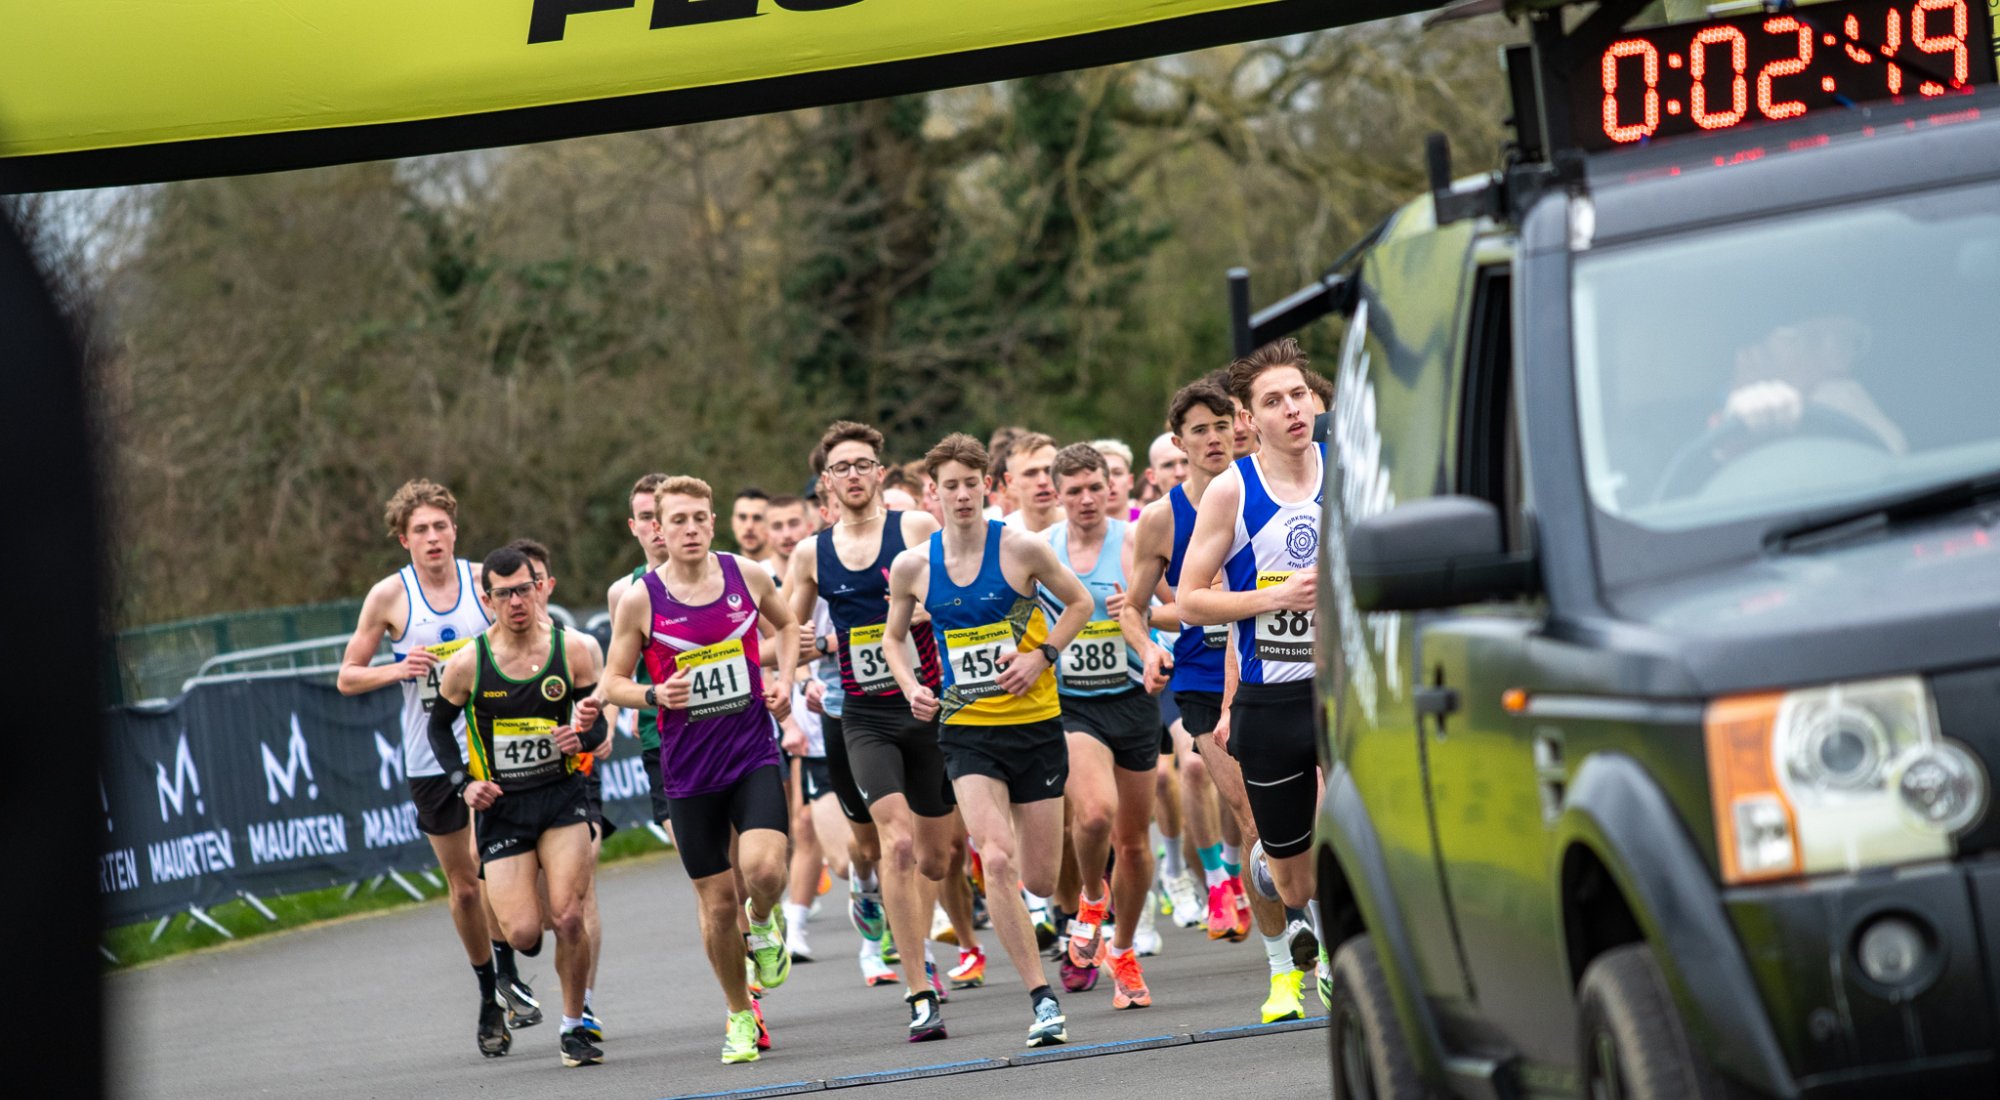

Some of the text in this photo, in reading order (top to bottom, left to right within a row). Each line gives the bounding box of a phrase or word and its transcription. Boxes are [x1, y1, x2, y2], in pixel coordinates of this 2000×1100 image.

[1602, 0, 1968, 142] 0:02:49
[947, 630, 978, 639] PODIUM
[678, 649, 712, 662] PODIUM
[702, 647, 741, 661] FESTIVAL
[860, 646, 889, 677] 39
[961, 644, 1010, 679] 456
[1069, 641, 1117, 672] 388
[692, 664, 738, 699] 441
[960, 684, 1001, 695] SPORTSSHO
[504, 738, 552, 764] 428
[148, 827, 236, 884] MAURTEN
